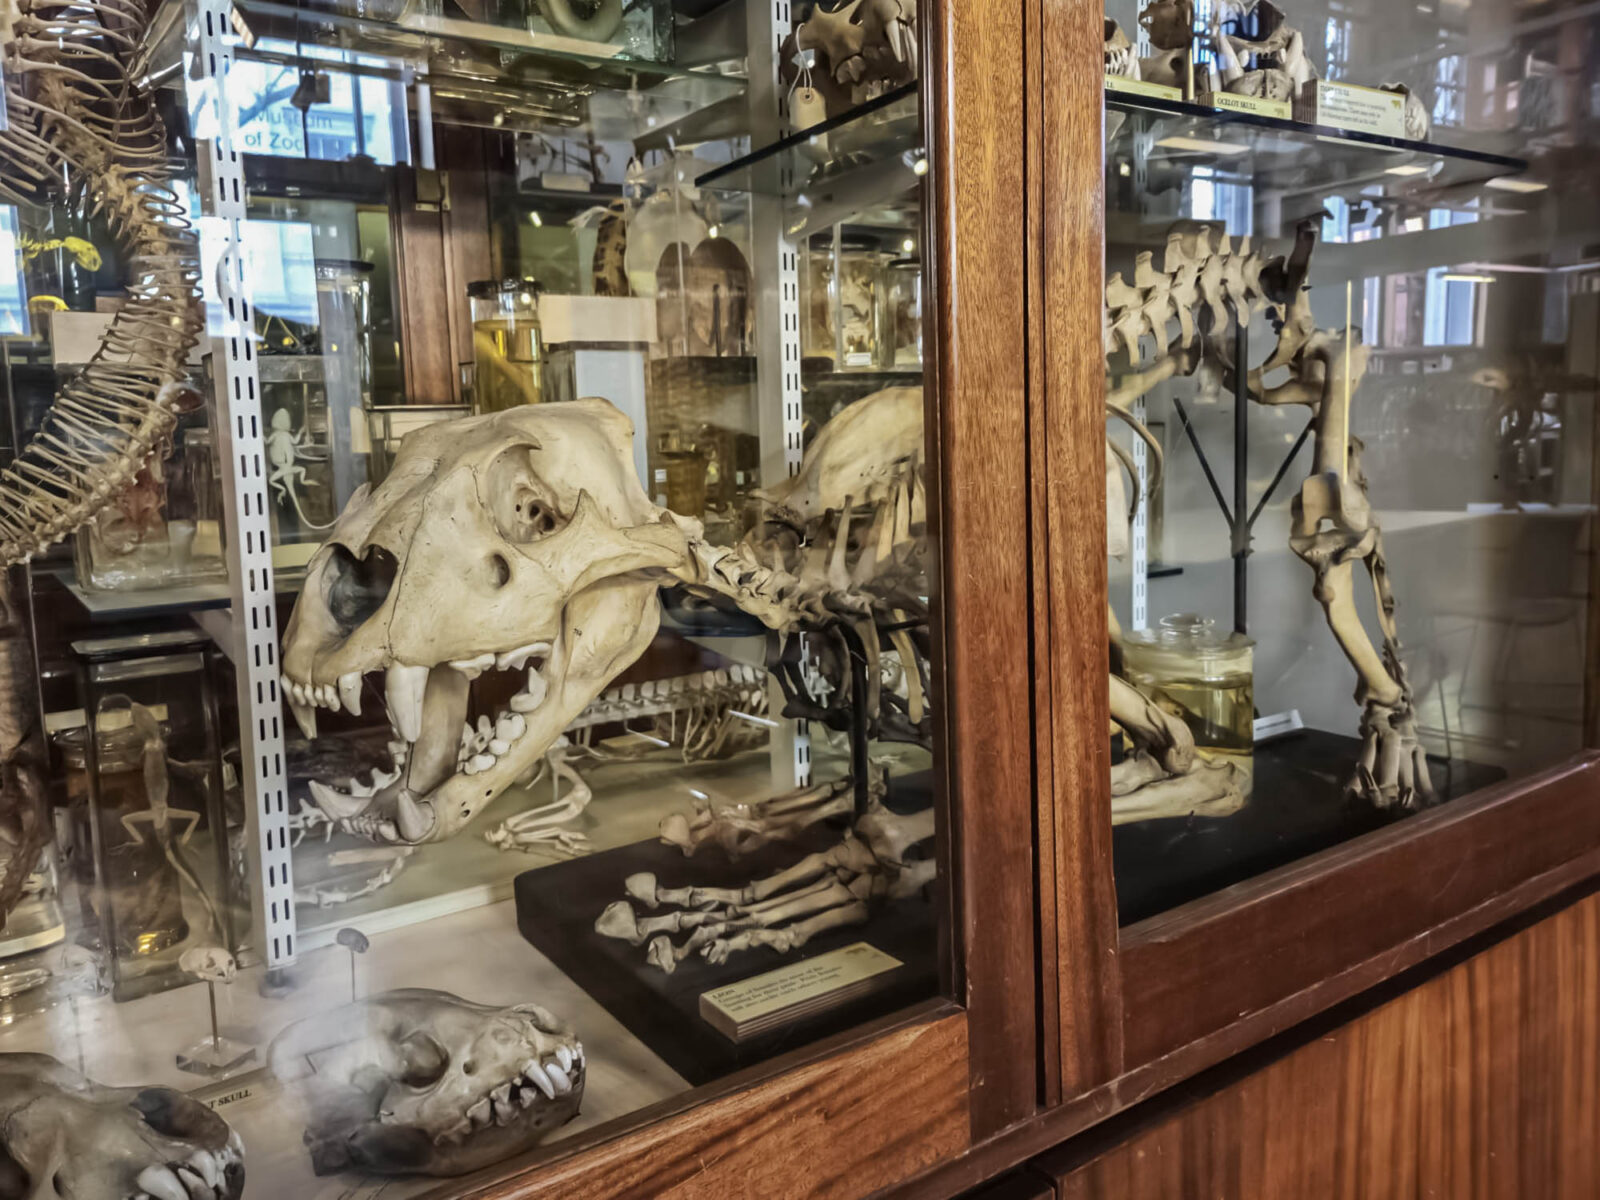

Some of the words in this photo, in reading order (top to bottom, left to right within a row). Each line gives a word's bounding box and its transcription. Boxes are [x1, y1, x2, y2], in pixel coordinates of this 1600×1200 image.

[1217, 97, 1240, 108] OCELOT
[1240, 101, 1257, 110] SKULL
[244, 131, 262, 147] of
[217, 1089, 253, 1106] SKULL
